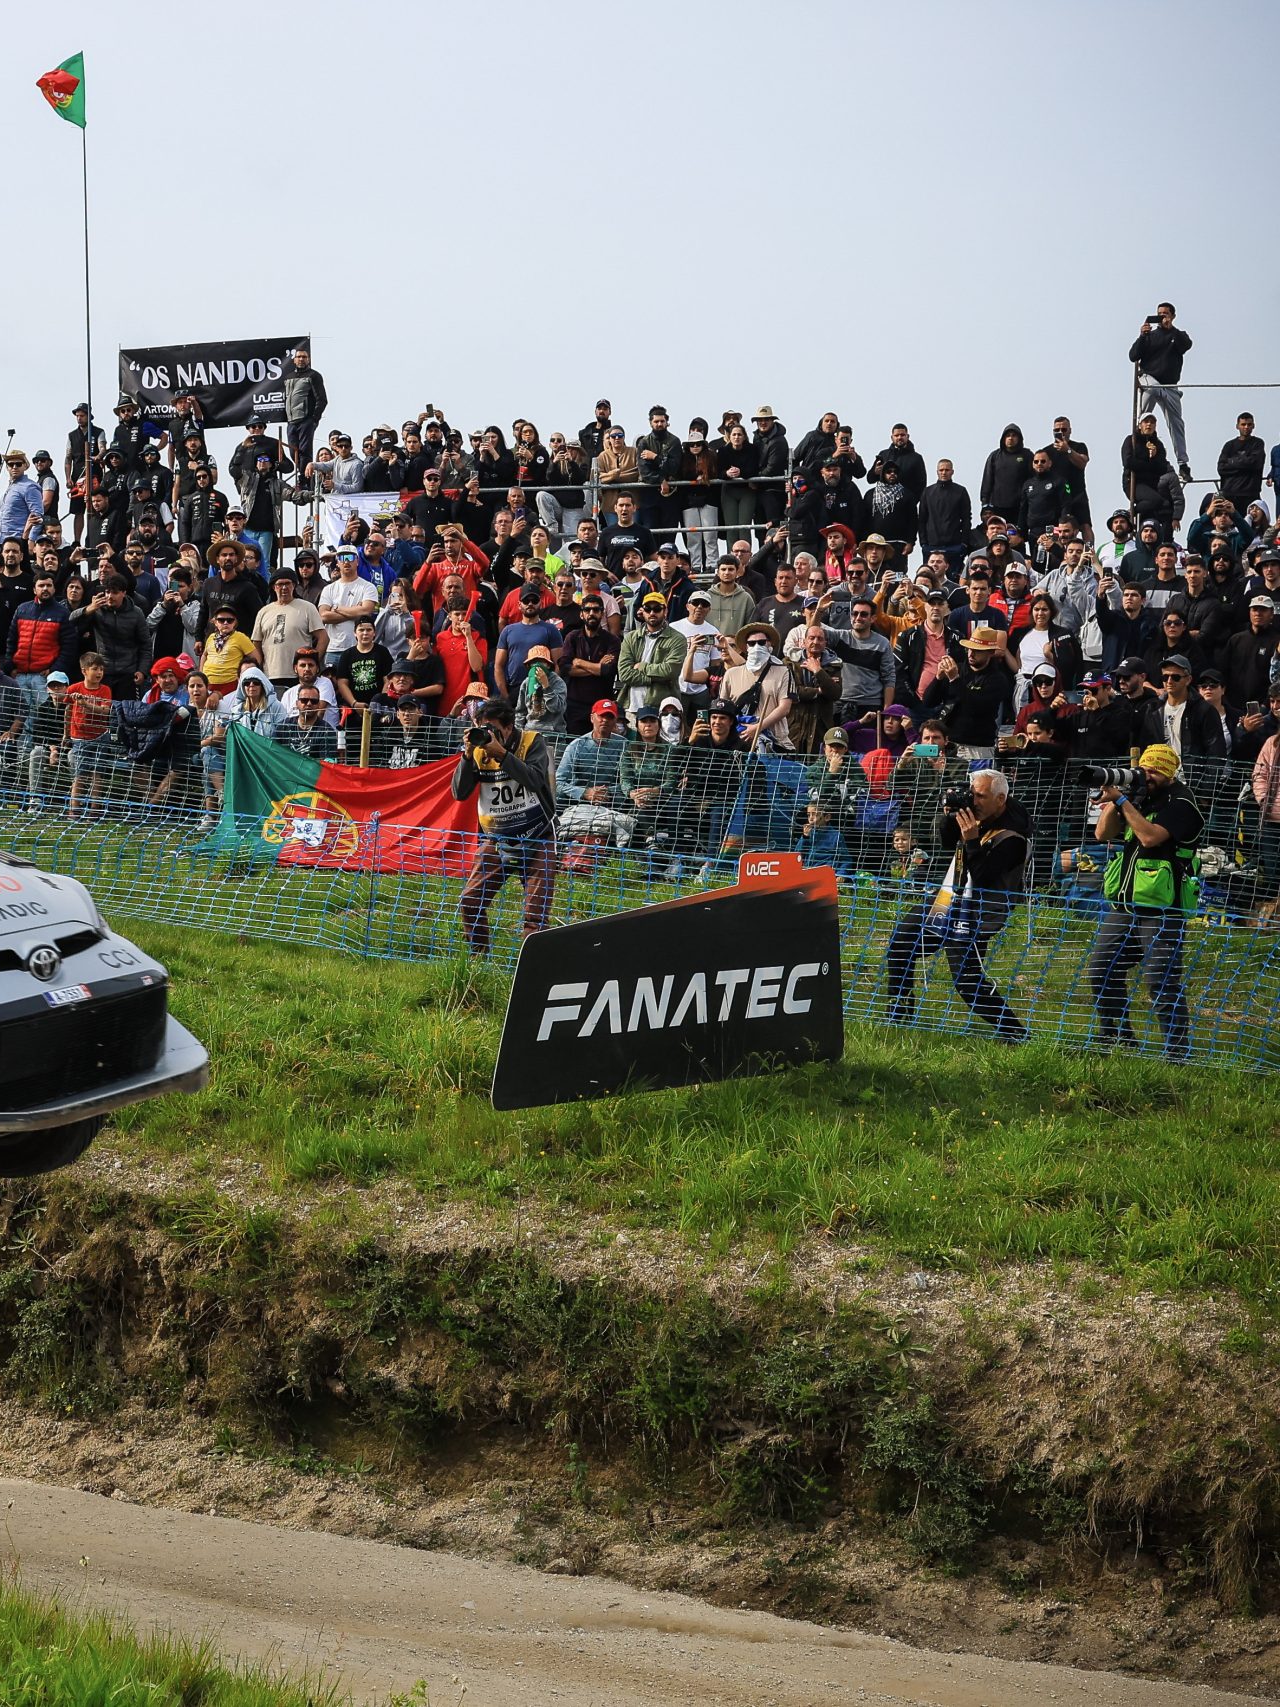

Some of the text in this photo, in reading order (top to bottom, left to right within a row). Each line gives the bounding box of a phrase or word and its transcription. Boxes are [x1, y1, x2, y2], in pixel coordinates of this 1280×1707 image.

[253, 392, 286, 403] WR
[491, 785, 526, 806] 204
[746, 861, 780, 876] WRC
[536, 962, 821, 1041] FANATEC
